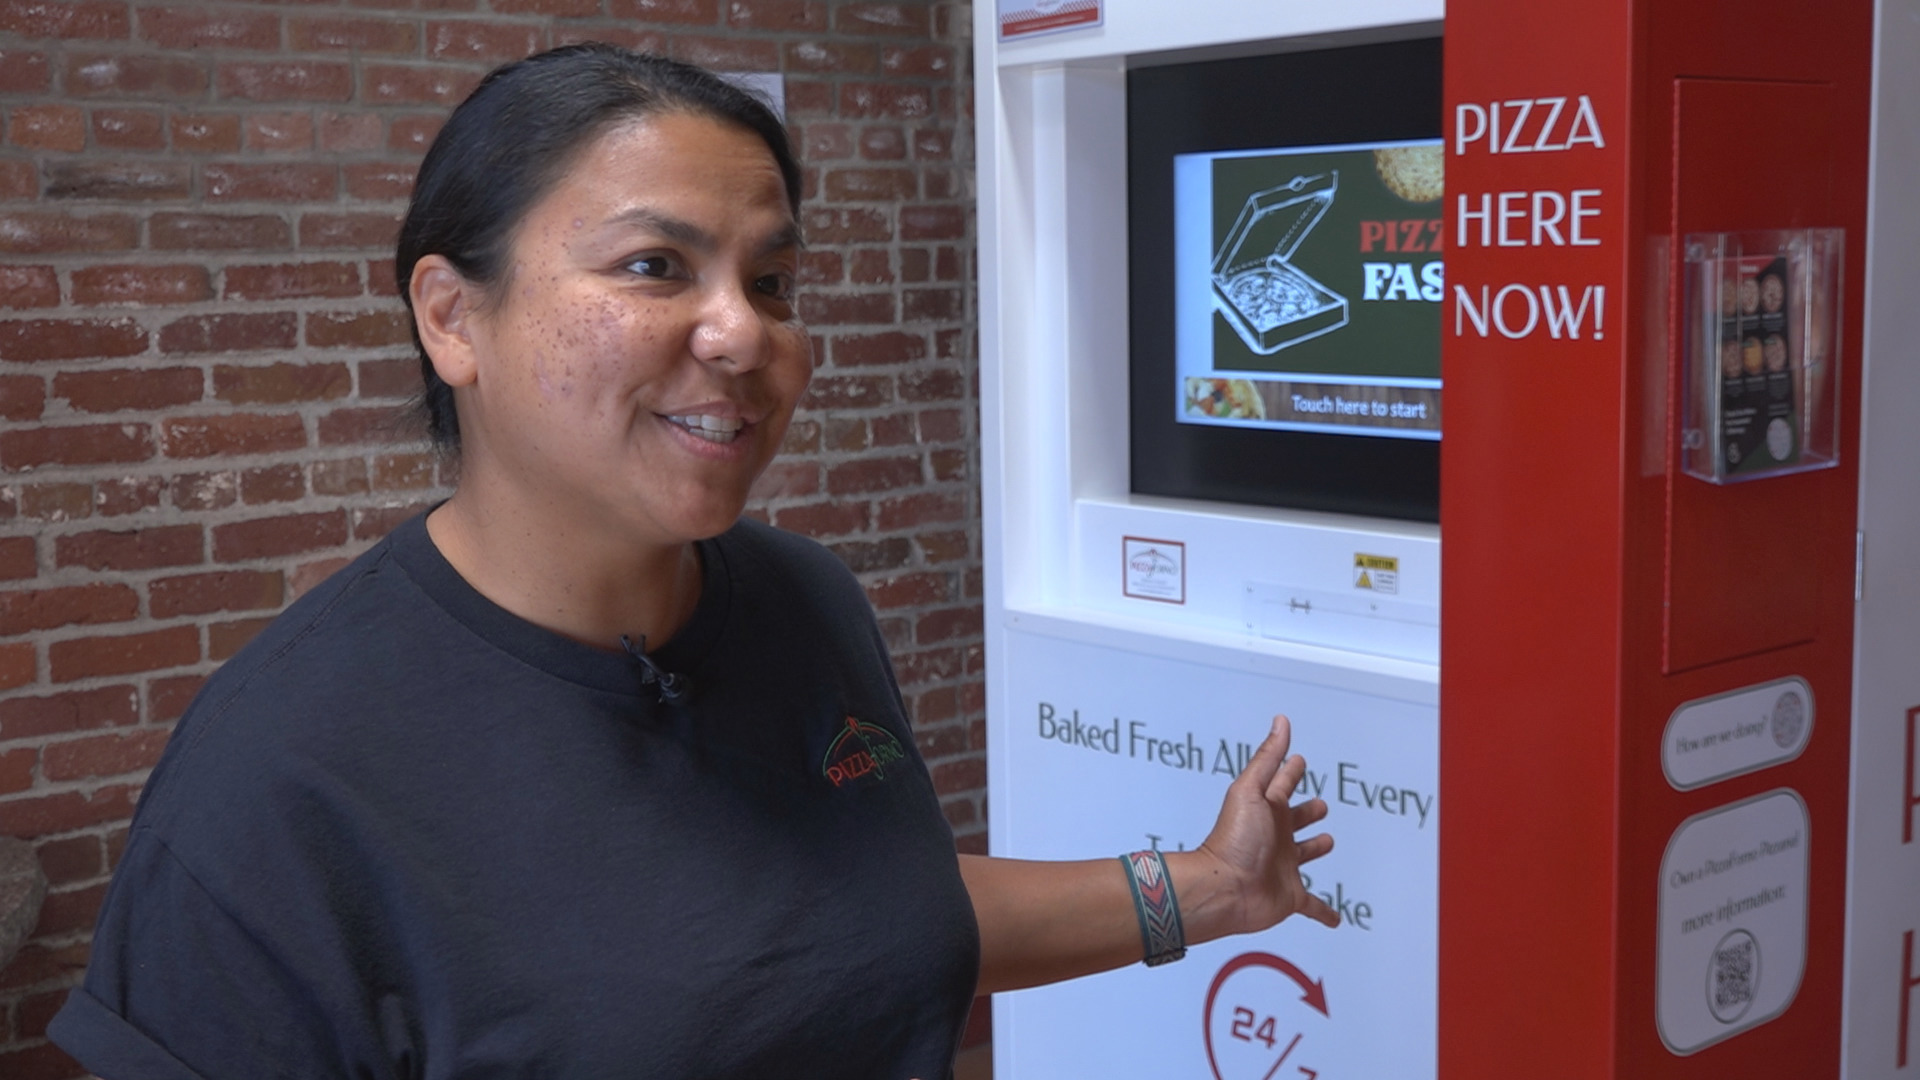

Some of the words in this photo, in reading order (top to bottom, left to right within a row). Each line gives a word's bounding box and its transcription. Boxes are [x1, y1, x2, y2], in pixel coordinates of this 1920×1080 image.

[1456, 95, 1605, 155] PIZZA
[1457, 189, 1602, 247] HERE
[1362, 261, 1444, 302] FAS
[1454, 283, 1606, 340] NOW!
[1291, 393, 1335, 413] Touch
[1335, 395, 1370, 416] here
[1371, 400, 1389, 417] to
[1390, 401, 1428, 420] start
[1038, 702, 1120, 755] Baked
[1129, 721, 1204, 773] Fresh
[1336, 761, 1434, 830] Every
